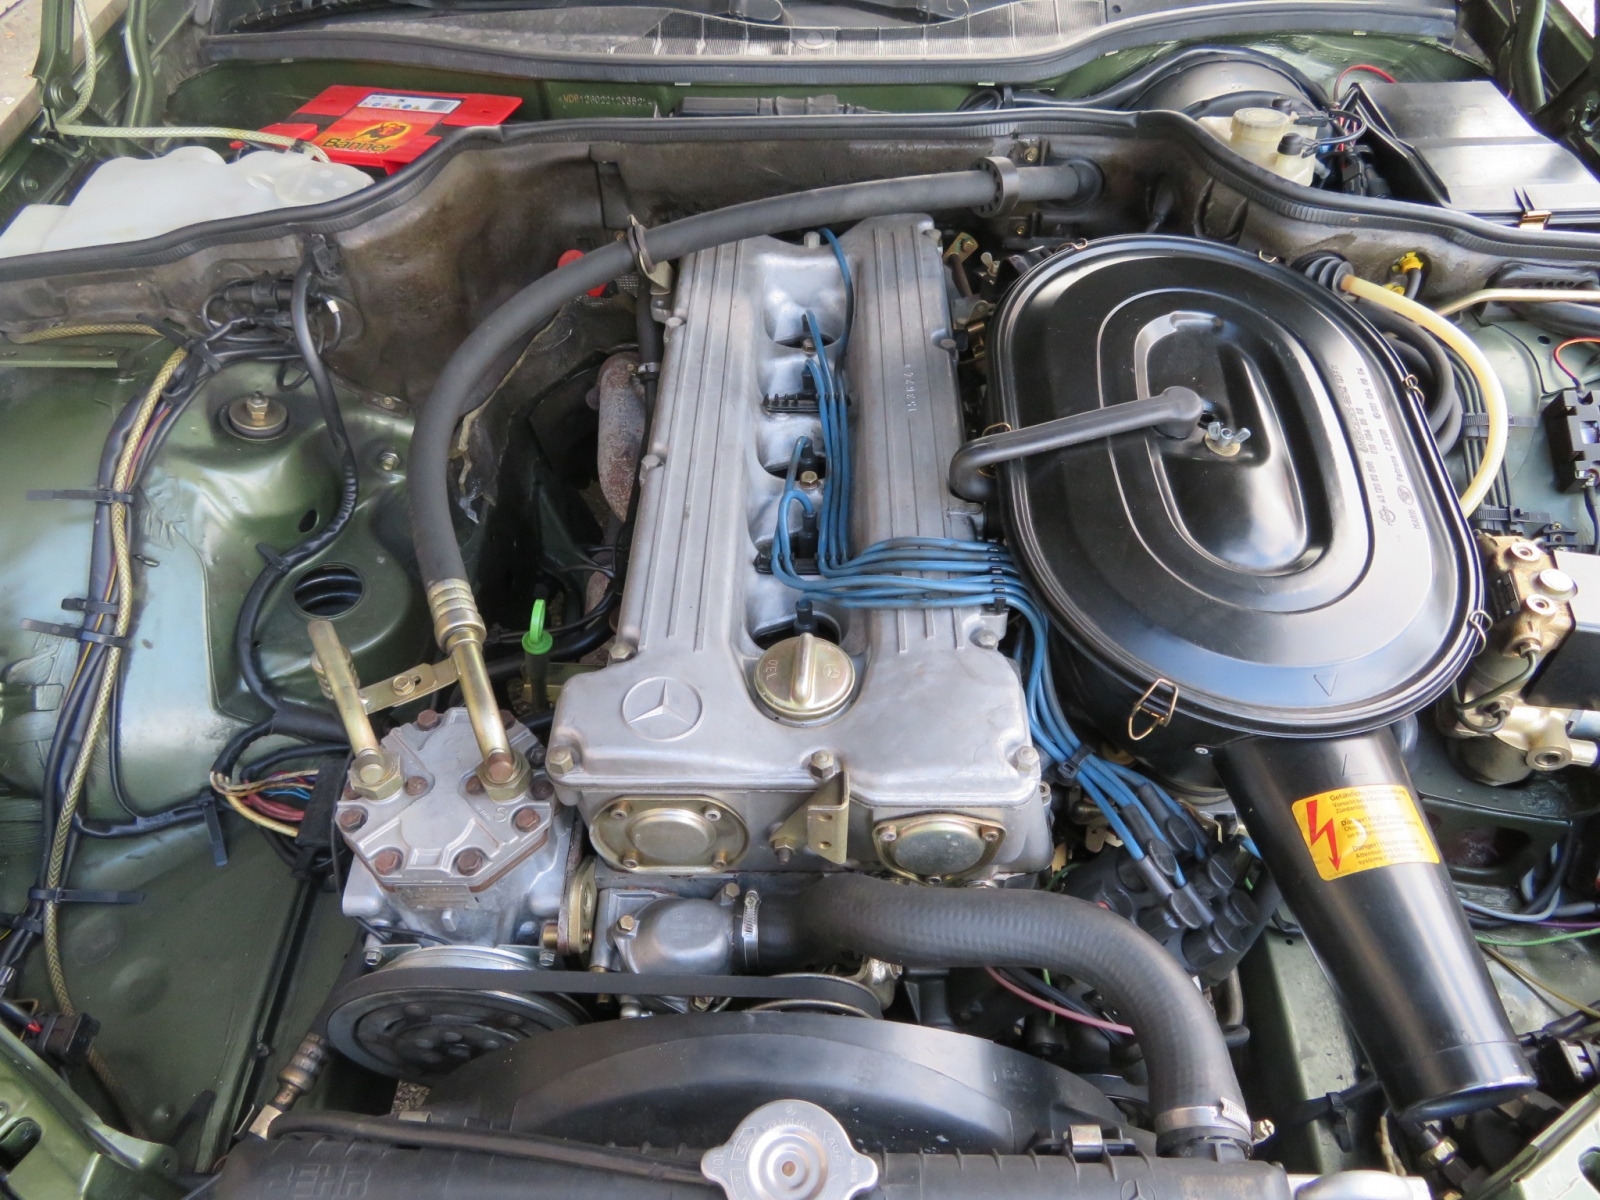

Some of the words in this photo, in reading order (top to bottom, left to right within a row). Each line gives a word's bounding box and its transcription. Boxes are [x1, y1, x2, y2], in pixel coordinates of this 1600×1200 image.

[321, 137, 393, 151] Banner
[765, 659, 779, 681] OEL
[1332, 799, 1356, 808] Vorsicht
[492, 806, 507, 823] S
[1352, 840, 1380, 852] Danger!
[1355, 849, 1382, 858] Attention
[827, 1136, 843, 1163] AUF
